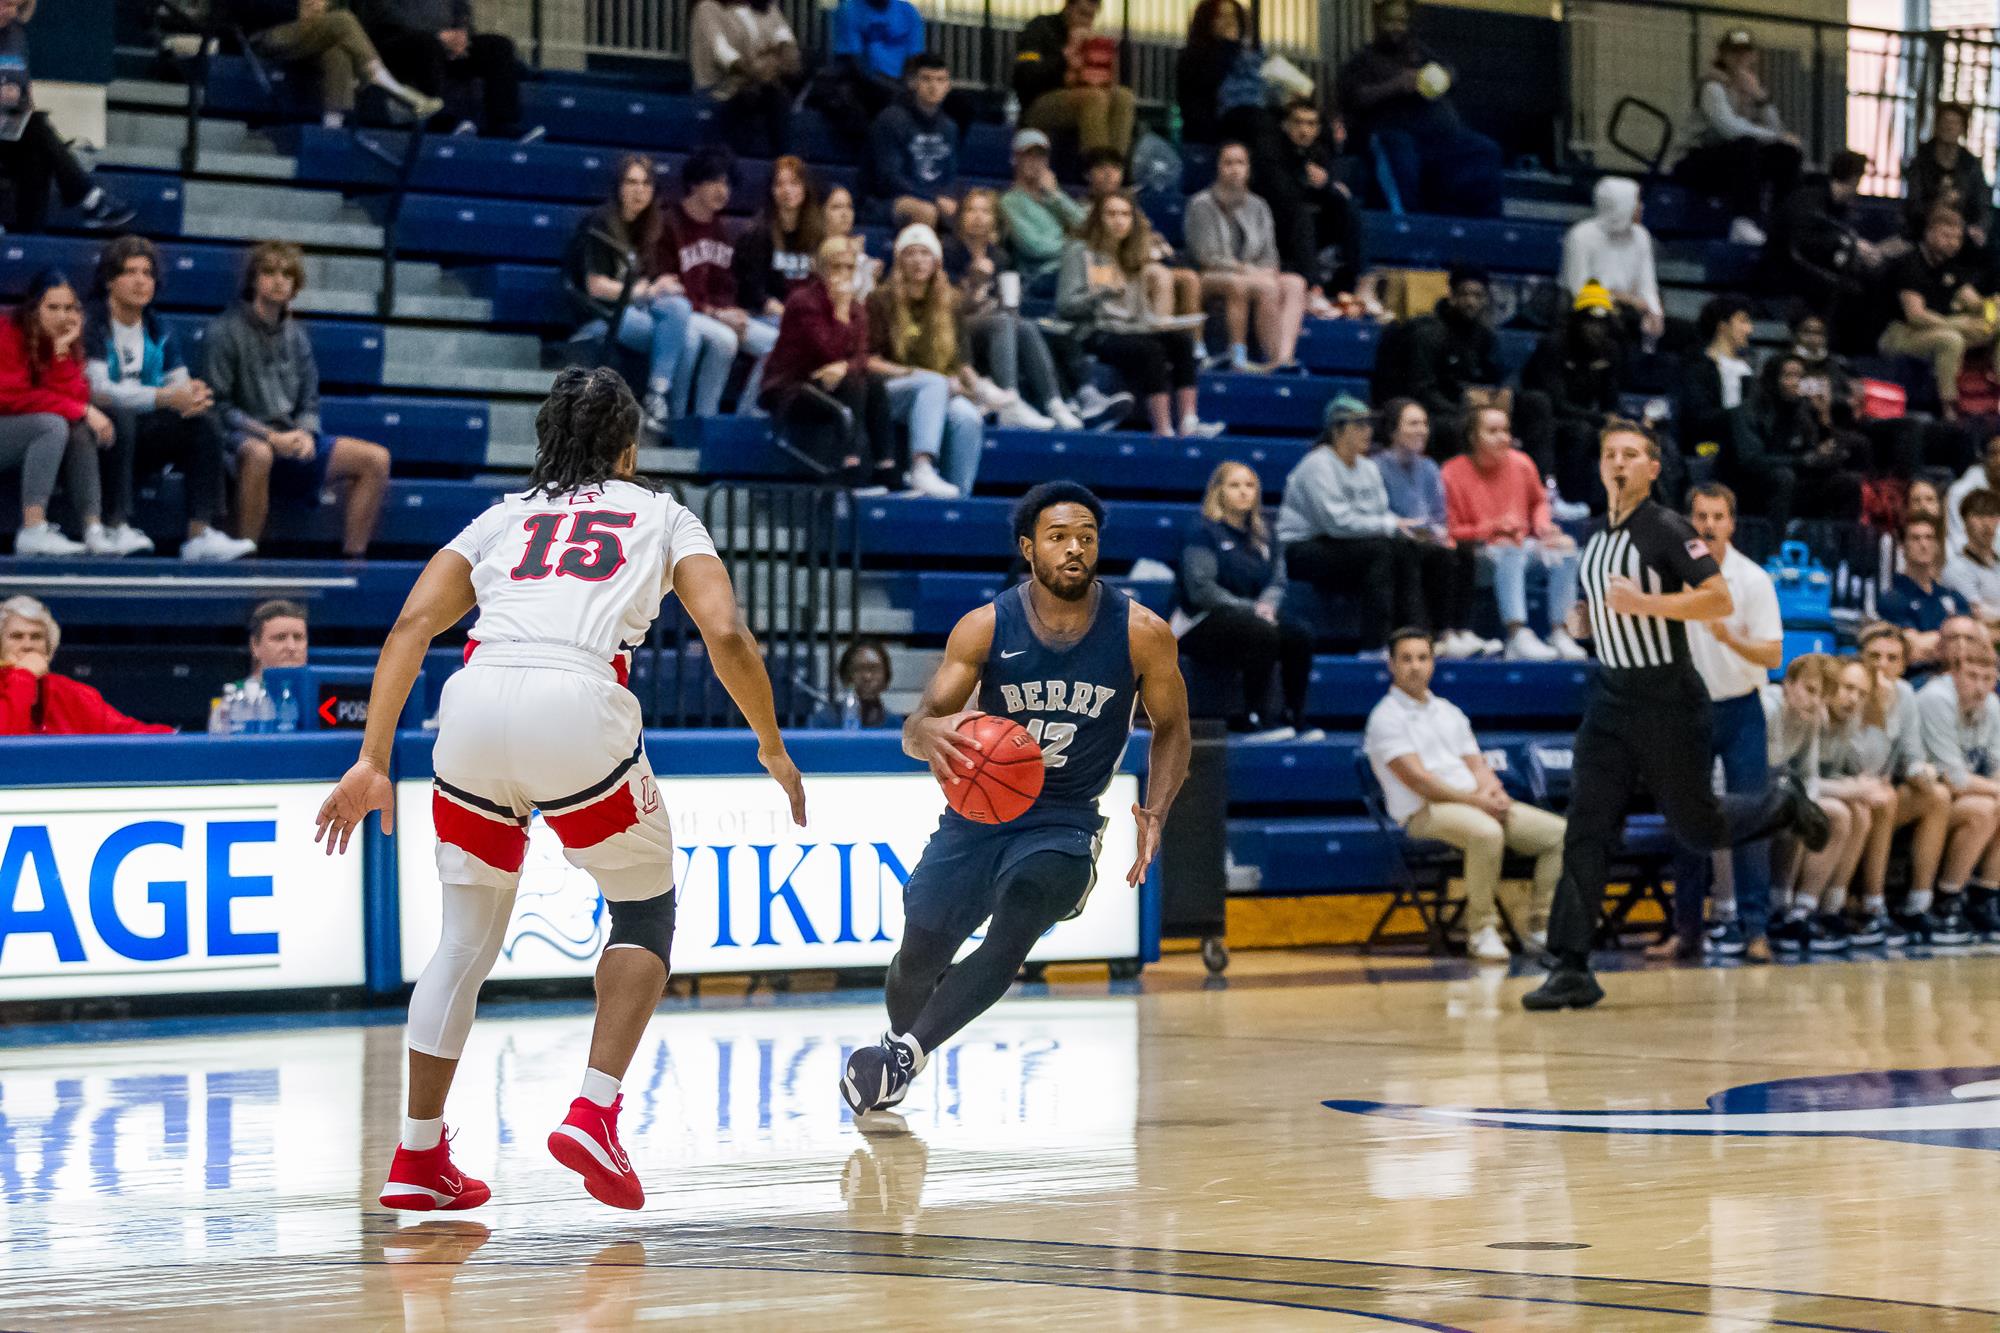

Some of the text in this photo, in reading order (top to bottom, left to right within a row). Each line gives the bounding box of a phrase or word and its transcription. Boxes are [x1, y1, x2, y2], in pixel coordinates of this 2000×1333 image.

[510, 509, 637, 583] 15
[338, 700, 368, 721] POS
[1000, 680, 1116, 719] BERRY
[0, 820, 281, 966] AGE
[676, 841, 1056, 948] IKIN
